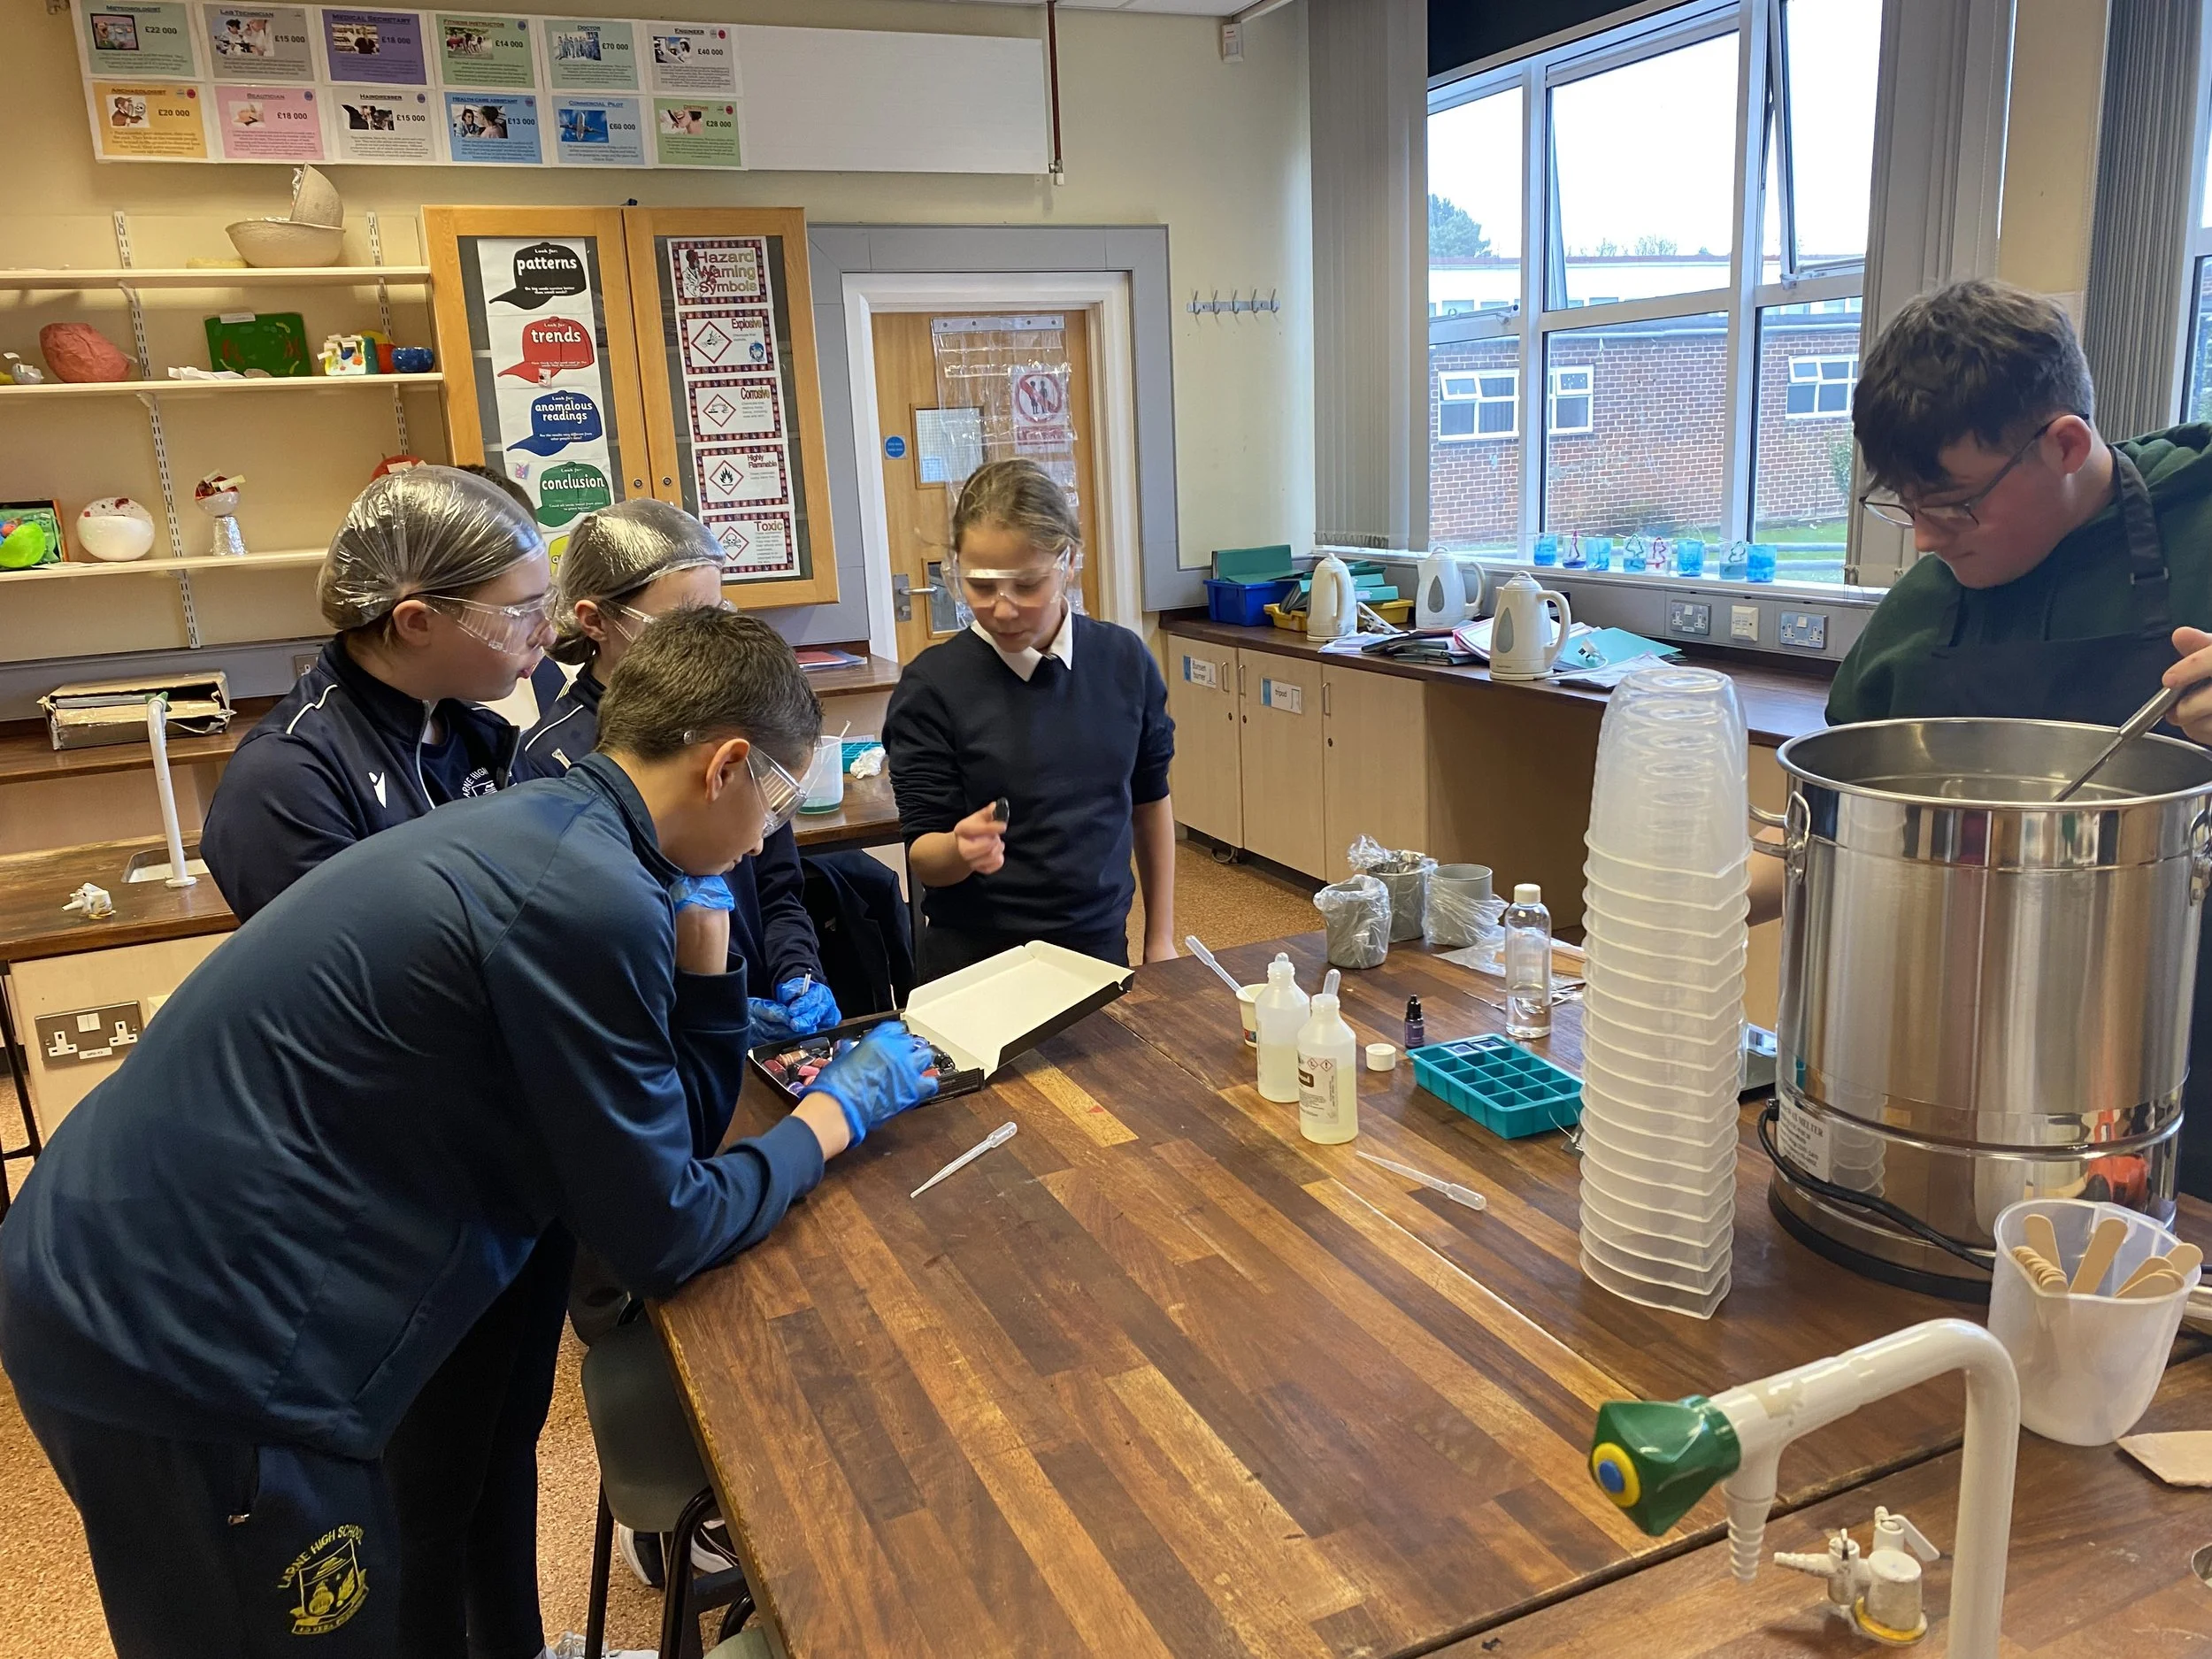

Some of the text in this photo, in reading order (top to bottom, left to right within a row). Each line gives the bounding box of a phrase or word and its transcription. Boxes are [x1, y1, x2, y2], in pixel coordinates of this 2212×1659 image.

[697, 250, 755, 264] Hazard
[517, 257, 577, 276] patterns
[699, 280, 758, 296] Symbols
[731, 317, 762, 331] Explosive
[531, 326, 581, 343] trends
[741, 387, 770, 400] Corrosive
[535, 400, 593, 411] anomalous
[542, 410, 588, 424] readings
[541, 473, 605, 490] conclusion
[754, 520, 783, 532] Toxic
[1275, 687, 1287, 698] tripod
[311, 1529, 335, 1555] HIGH
[337, 1525, 365, 1546] SCHOOL
